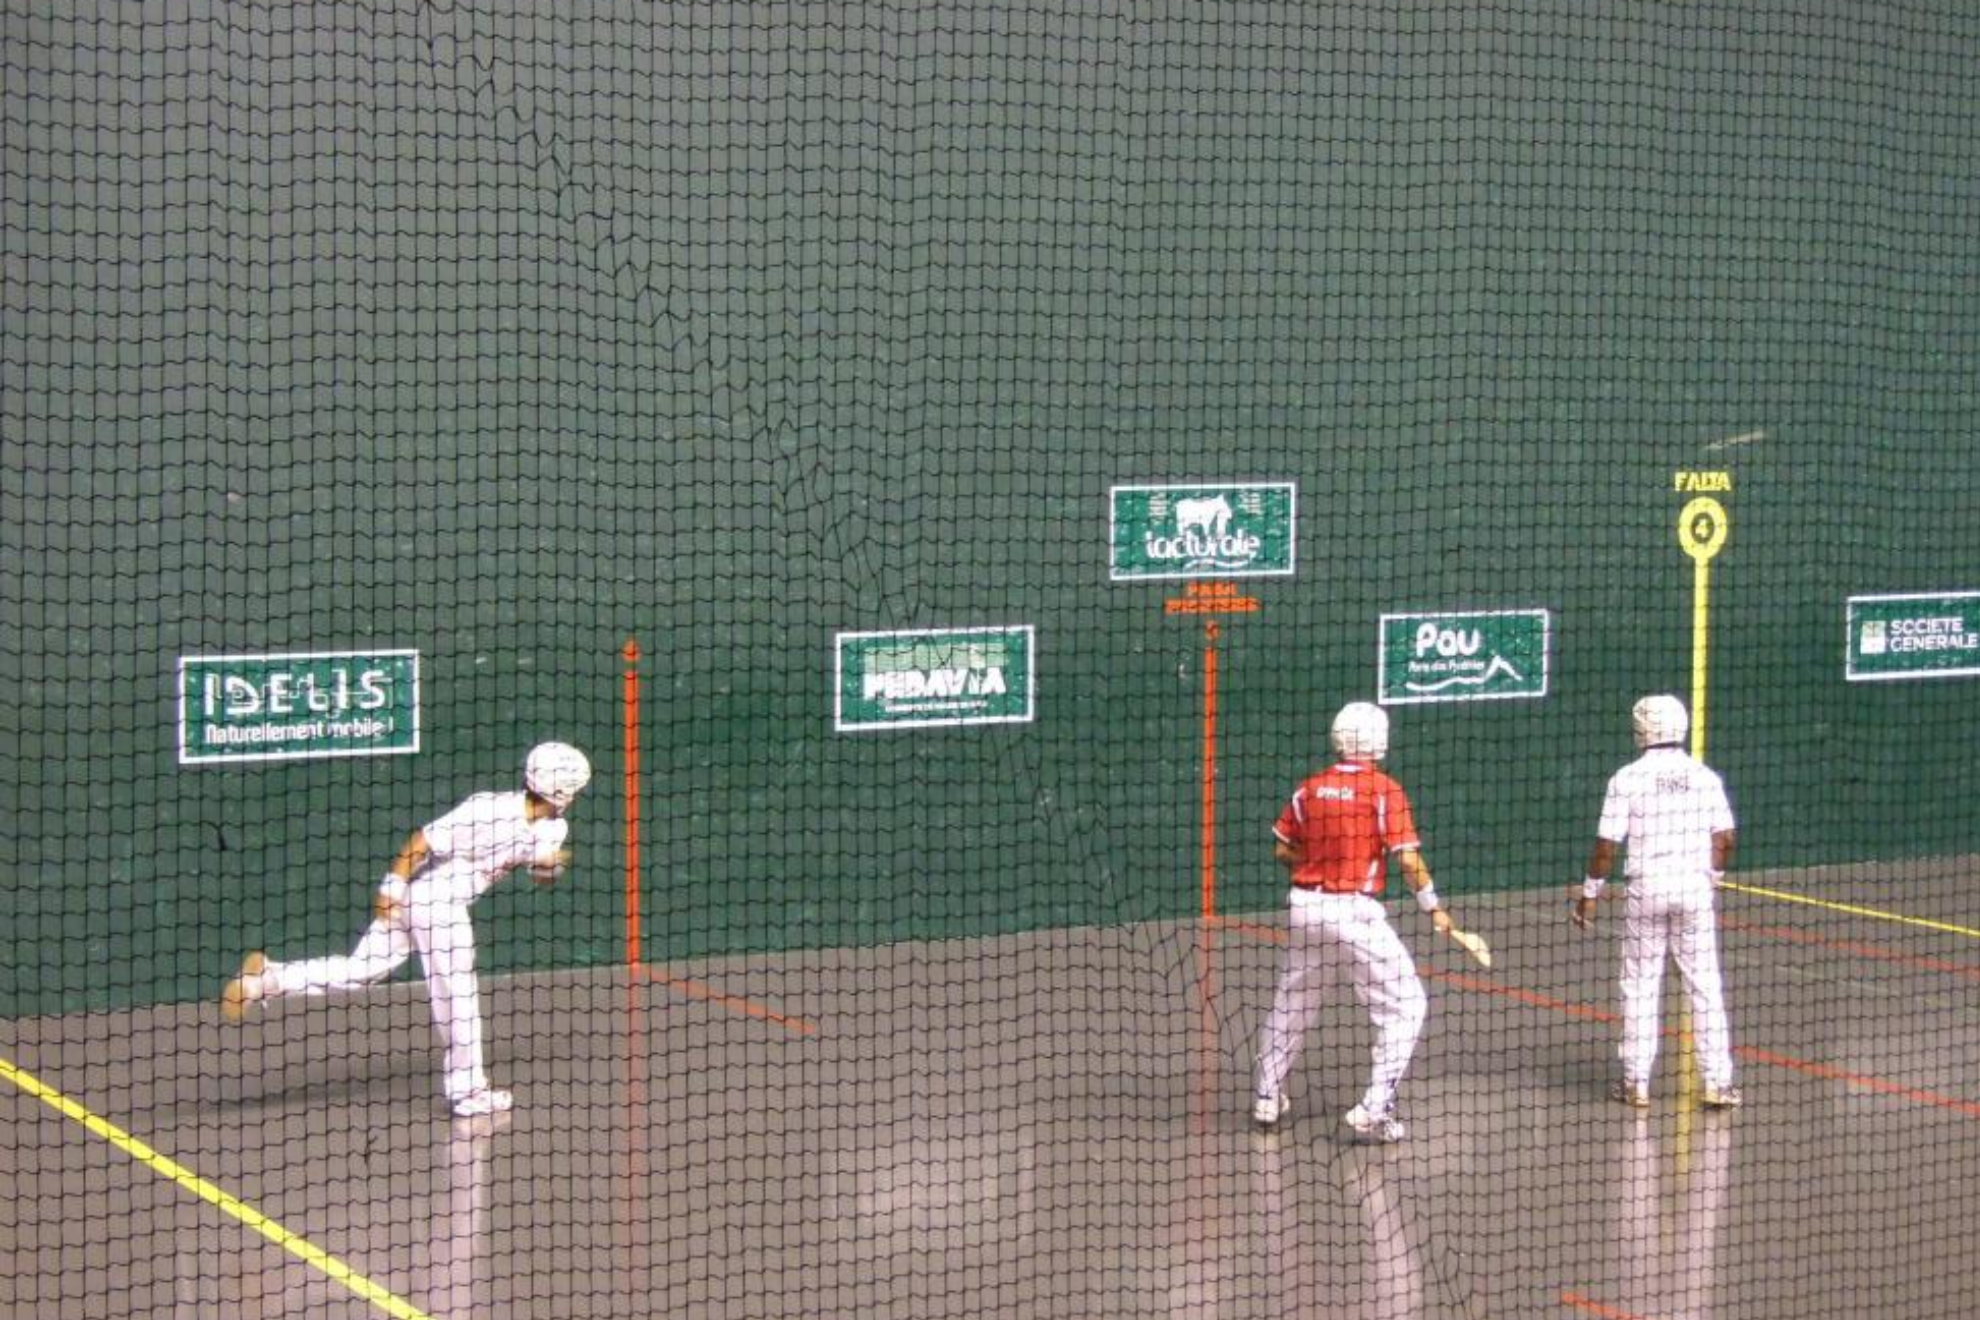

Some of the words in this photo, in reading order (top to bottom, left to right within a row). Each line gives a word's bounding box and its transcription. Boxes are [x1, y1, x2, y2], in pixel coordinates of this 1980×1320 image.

[1674, 471, 1732, 491] FALTA
[1416, 622, 1481, 658] Pau
[205, 720, 324, 745] Naturellement
